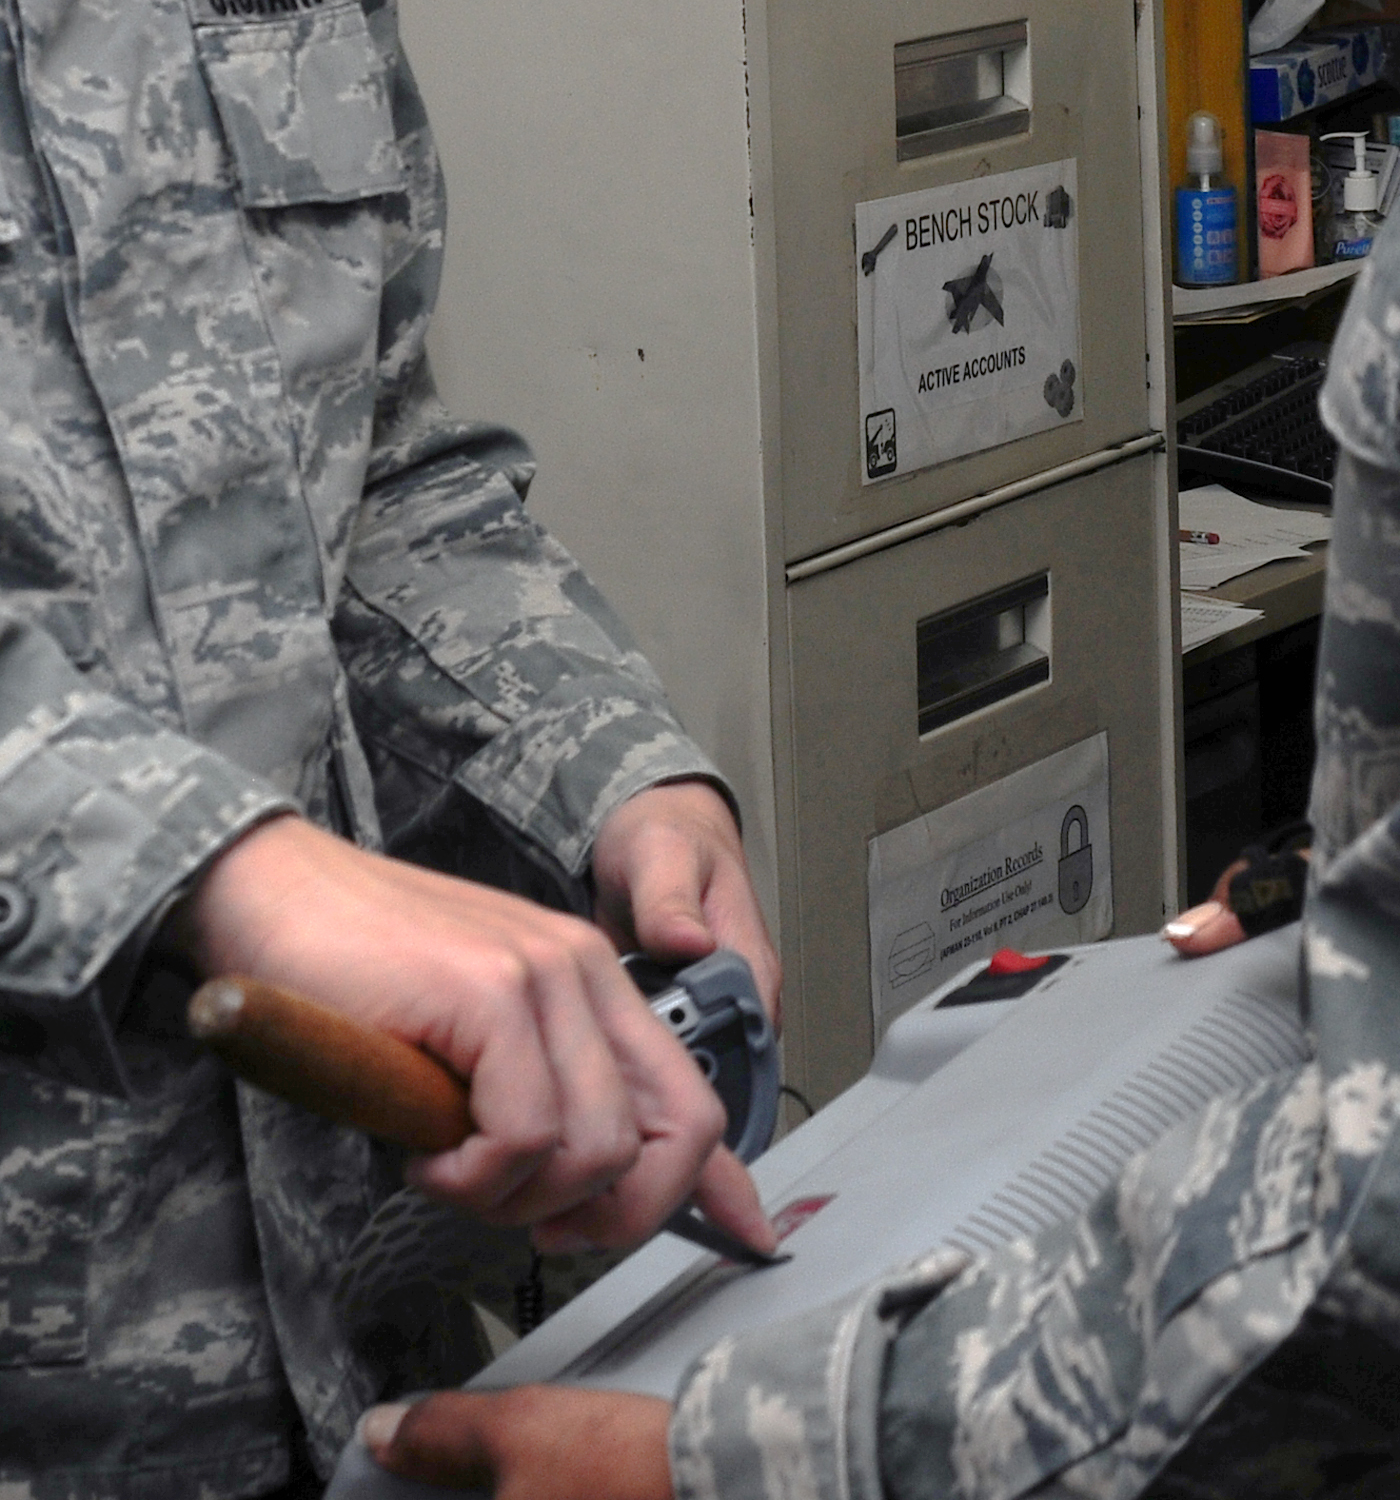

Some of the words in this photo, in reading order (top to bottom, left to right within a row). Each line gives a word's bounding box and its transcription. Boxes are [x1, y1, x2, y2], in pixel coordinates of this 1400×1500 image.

[906, 205, 971, 251] BENCH
[978, 190, 1039, 234] STOCK
[918, 363, 960, 393] ACTIVE
[963, 346, 1026, 381] ACCOUNTS
[941, 867, 1003, 908] Organization
[1005, 841, 1043, 876] Records
[950, 918, 961, 931] For
[963, 898, 1000, 925] Information
[1002, 891, 1014, 904] Use
